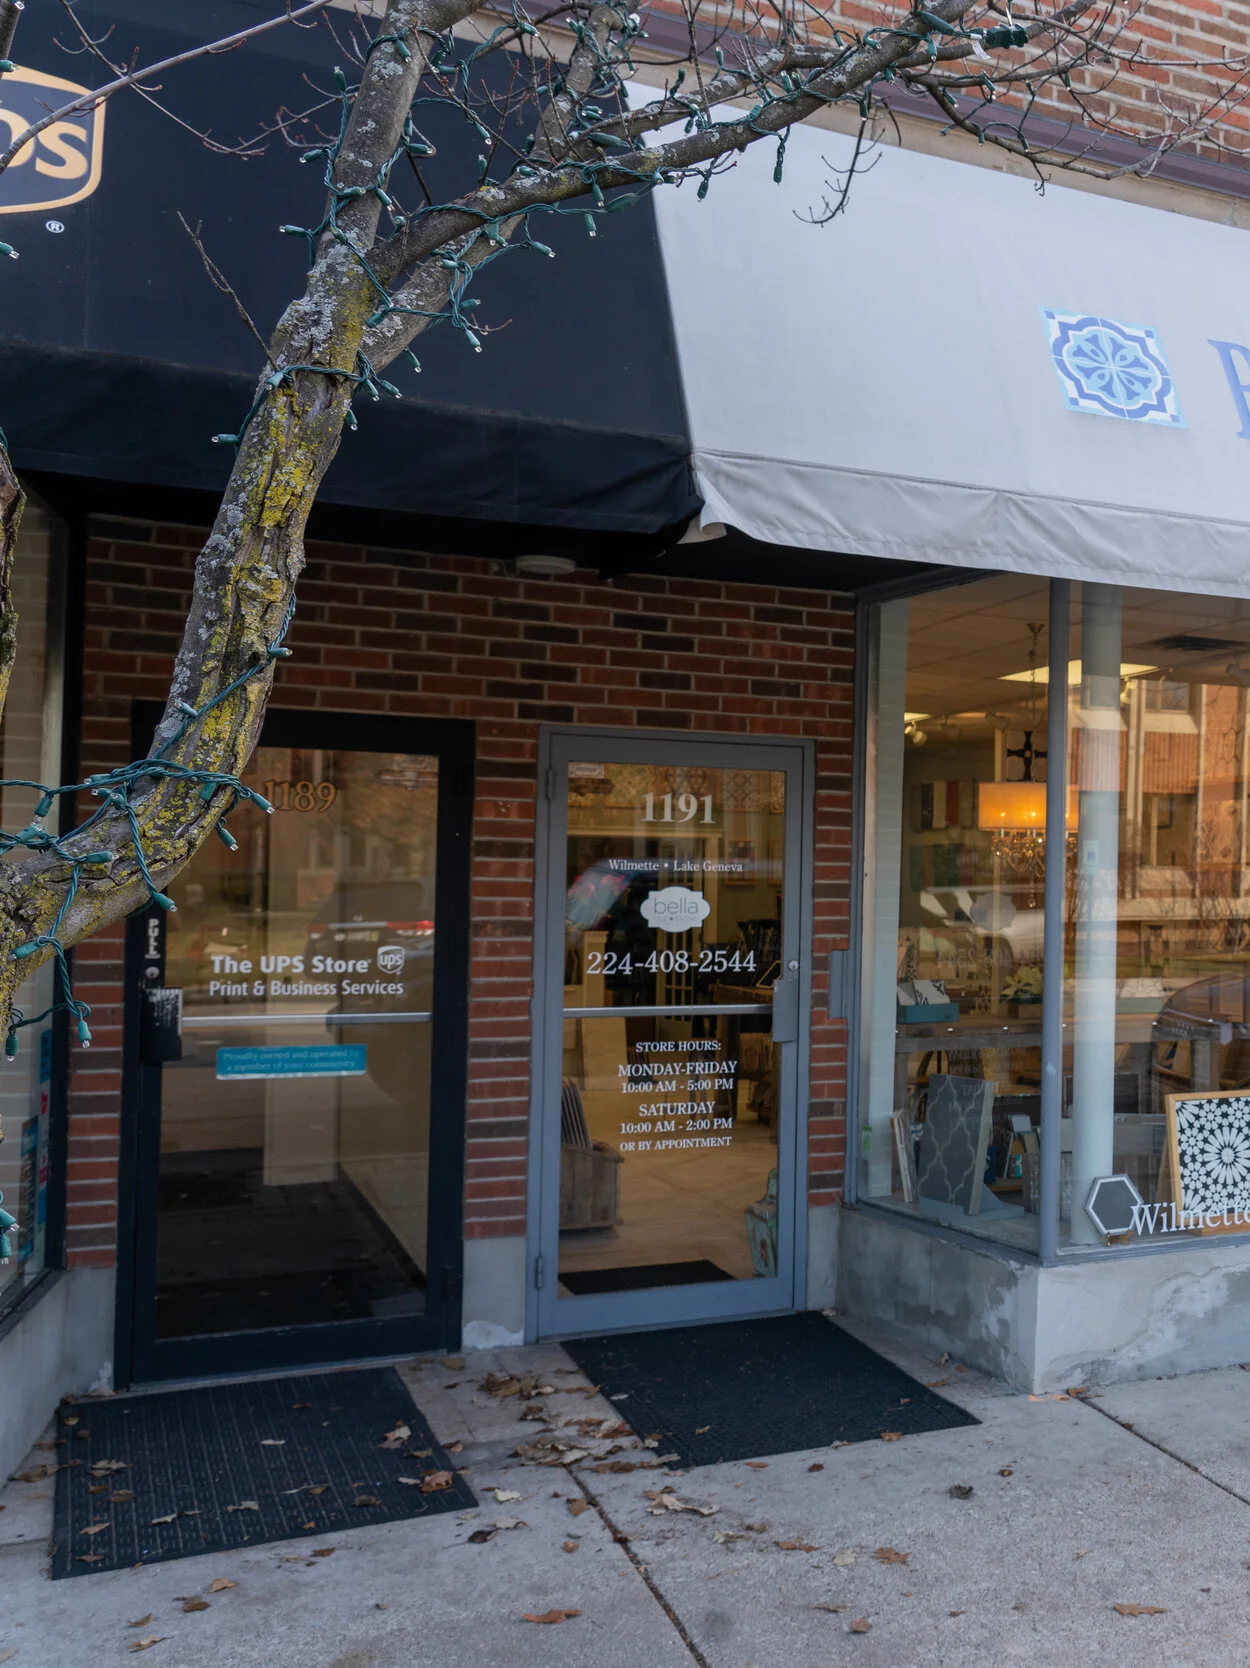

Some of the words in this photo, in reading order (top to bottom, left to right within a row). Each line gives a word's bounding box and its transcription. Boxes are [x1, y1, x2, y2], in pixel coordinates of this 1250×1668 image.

[264, 779, 336, 813] 1189
[641, 792, 716, 824] 1191
[608, 859, 660, 872] Wilmette
[673, 860, 700, 872] Lake
[703, 860, 743, 873] Geneva
[653, 897, 699, 915] bella
[210, 955, 253, 974] The
[260, 955, 305, 974] UPS
[311, 955, 369, 974] Store
[586, 949, 757, 975] 224-408-2544
[209, 980, 248, 997] Print
[253, 980, 266, 996] &
[270, 980, 337, 996] Business
[341, 979, 404, 995] Services
[635, 1041, 675, 1053] STORE
[678, 1040, 722, 1052] HOURS:
[618, 1061, 738, 1077] MONDAY-FRIDAY
[621, 1082, 653, 1094] 10:00
[655, 1080, 677, 1092] AM
[687, 1079, 712, 1091] 5:00
[714, 1078, 734, 1090] PM
[638, 1101, 716, 1117] SATURDAY
[620, 1122, 652, 1134] 10:00
[654, 1120, 676, 1133] AM
[685, 1119, 711, 1131] 2:00
[713, 1117, 733, 1129] PM
[619, 1142, 636, 1152] OR
[637, 1141, 653, 1151] BY
[654, 1136, 733, 1150] APPOINTMENT
